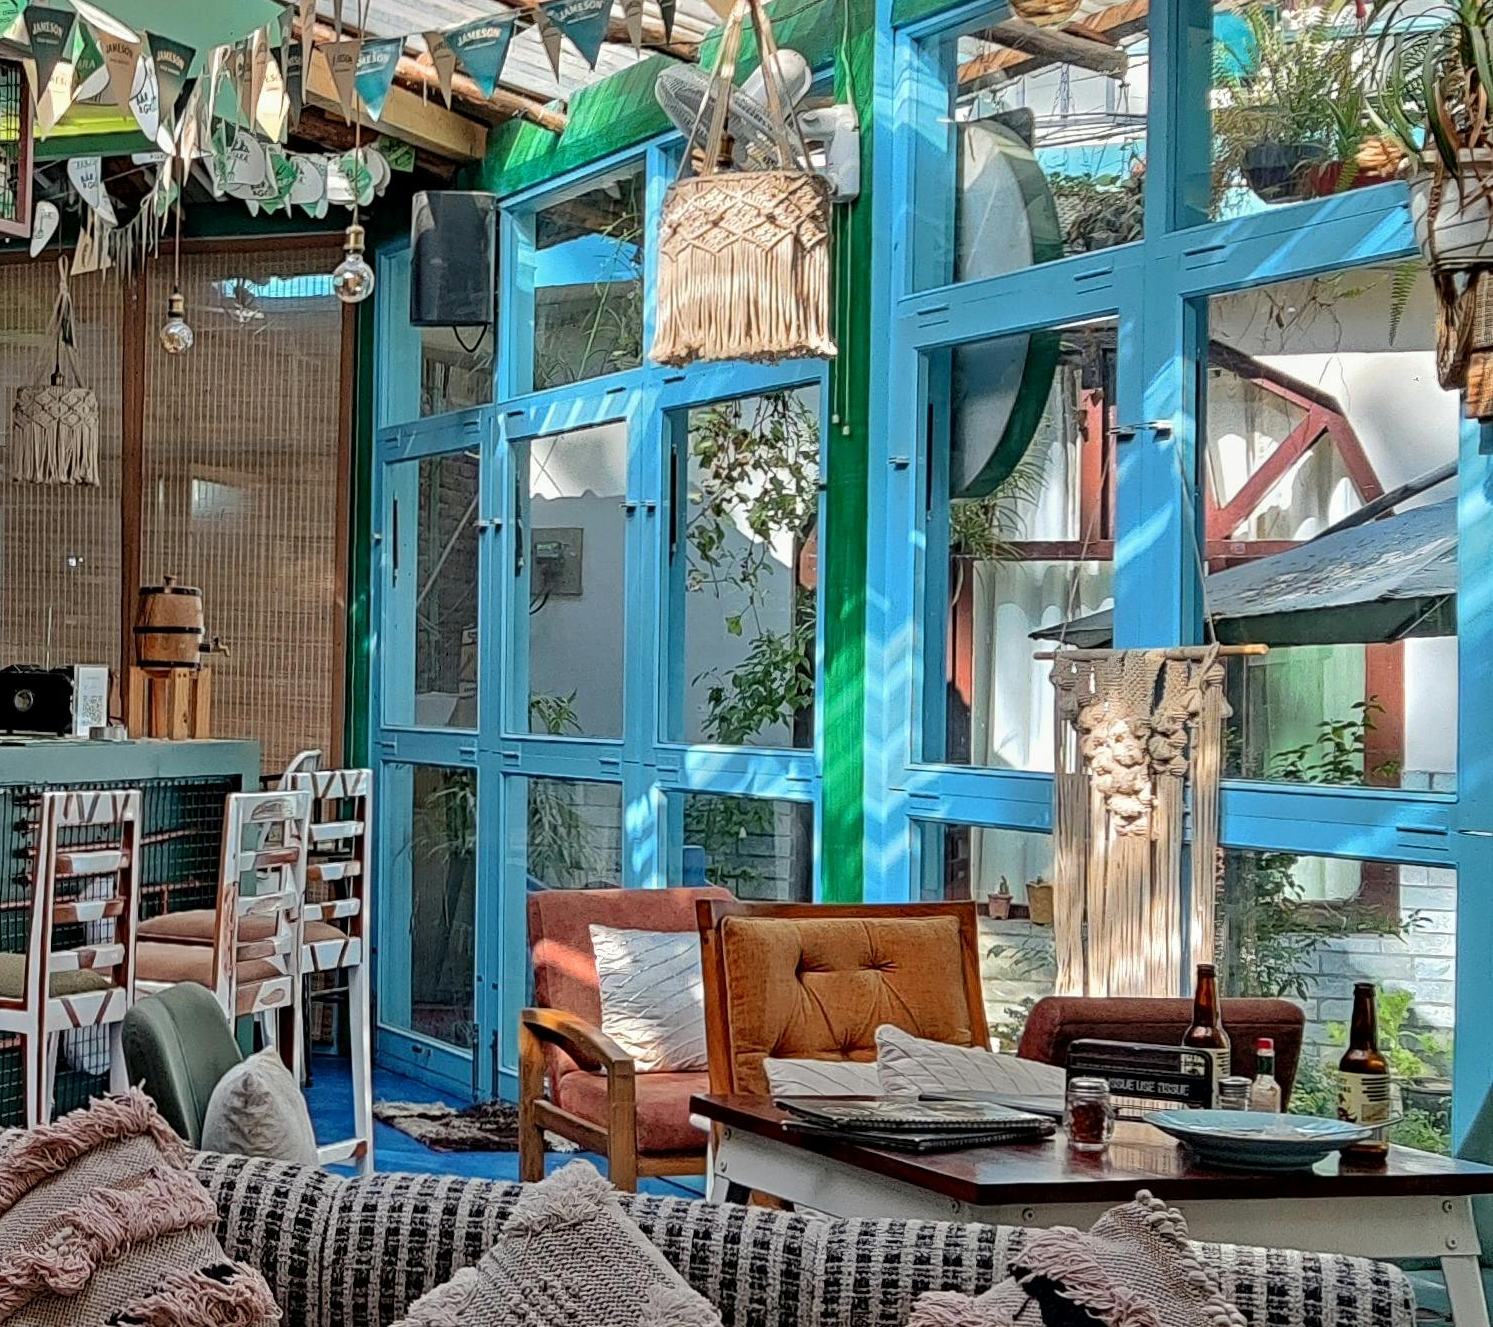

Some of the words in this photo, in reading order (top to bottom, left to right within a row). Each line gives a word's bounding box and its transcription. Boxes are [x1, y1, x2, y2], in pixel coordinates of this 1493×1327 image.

[33, 22, 64, 40] JAMESON
[457, 27, 503, 47] JAMESON
[156, 50, 185, 68] JAMESON
[1136, 1080, 1156, 1092] USE
[1158, 1081, 1190, 1097] TISSUE
